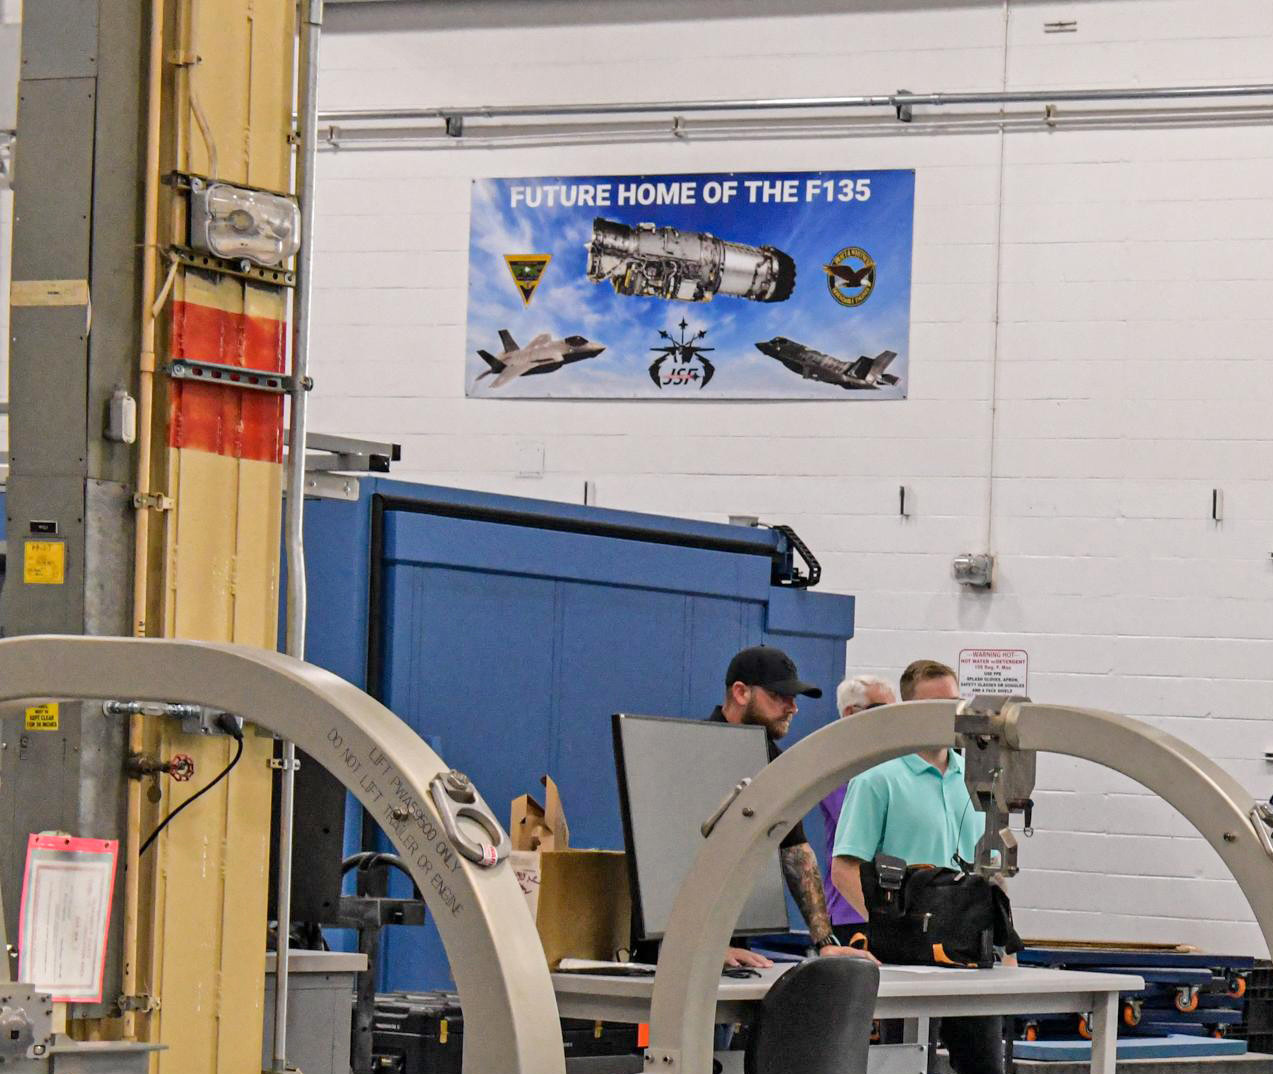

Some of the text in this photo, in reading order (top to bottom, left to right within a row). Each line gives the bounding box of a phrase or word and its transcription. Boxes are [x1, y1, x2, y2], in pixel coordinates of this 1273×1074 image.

[510, 178, 872, 208] FUTURE HOME OF THE F135
[662, 368, 700, 385] JSF
[327, 727, 465, 918] DO NOT LIFT TRAILER OR ENGINE
[369, 747, 393, 775] LIFT
[435, 842, 462, 873] ONLY
